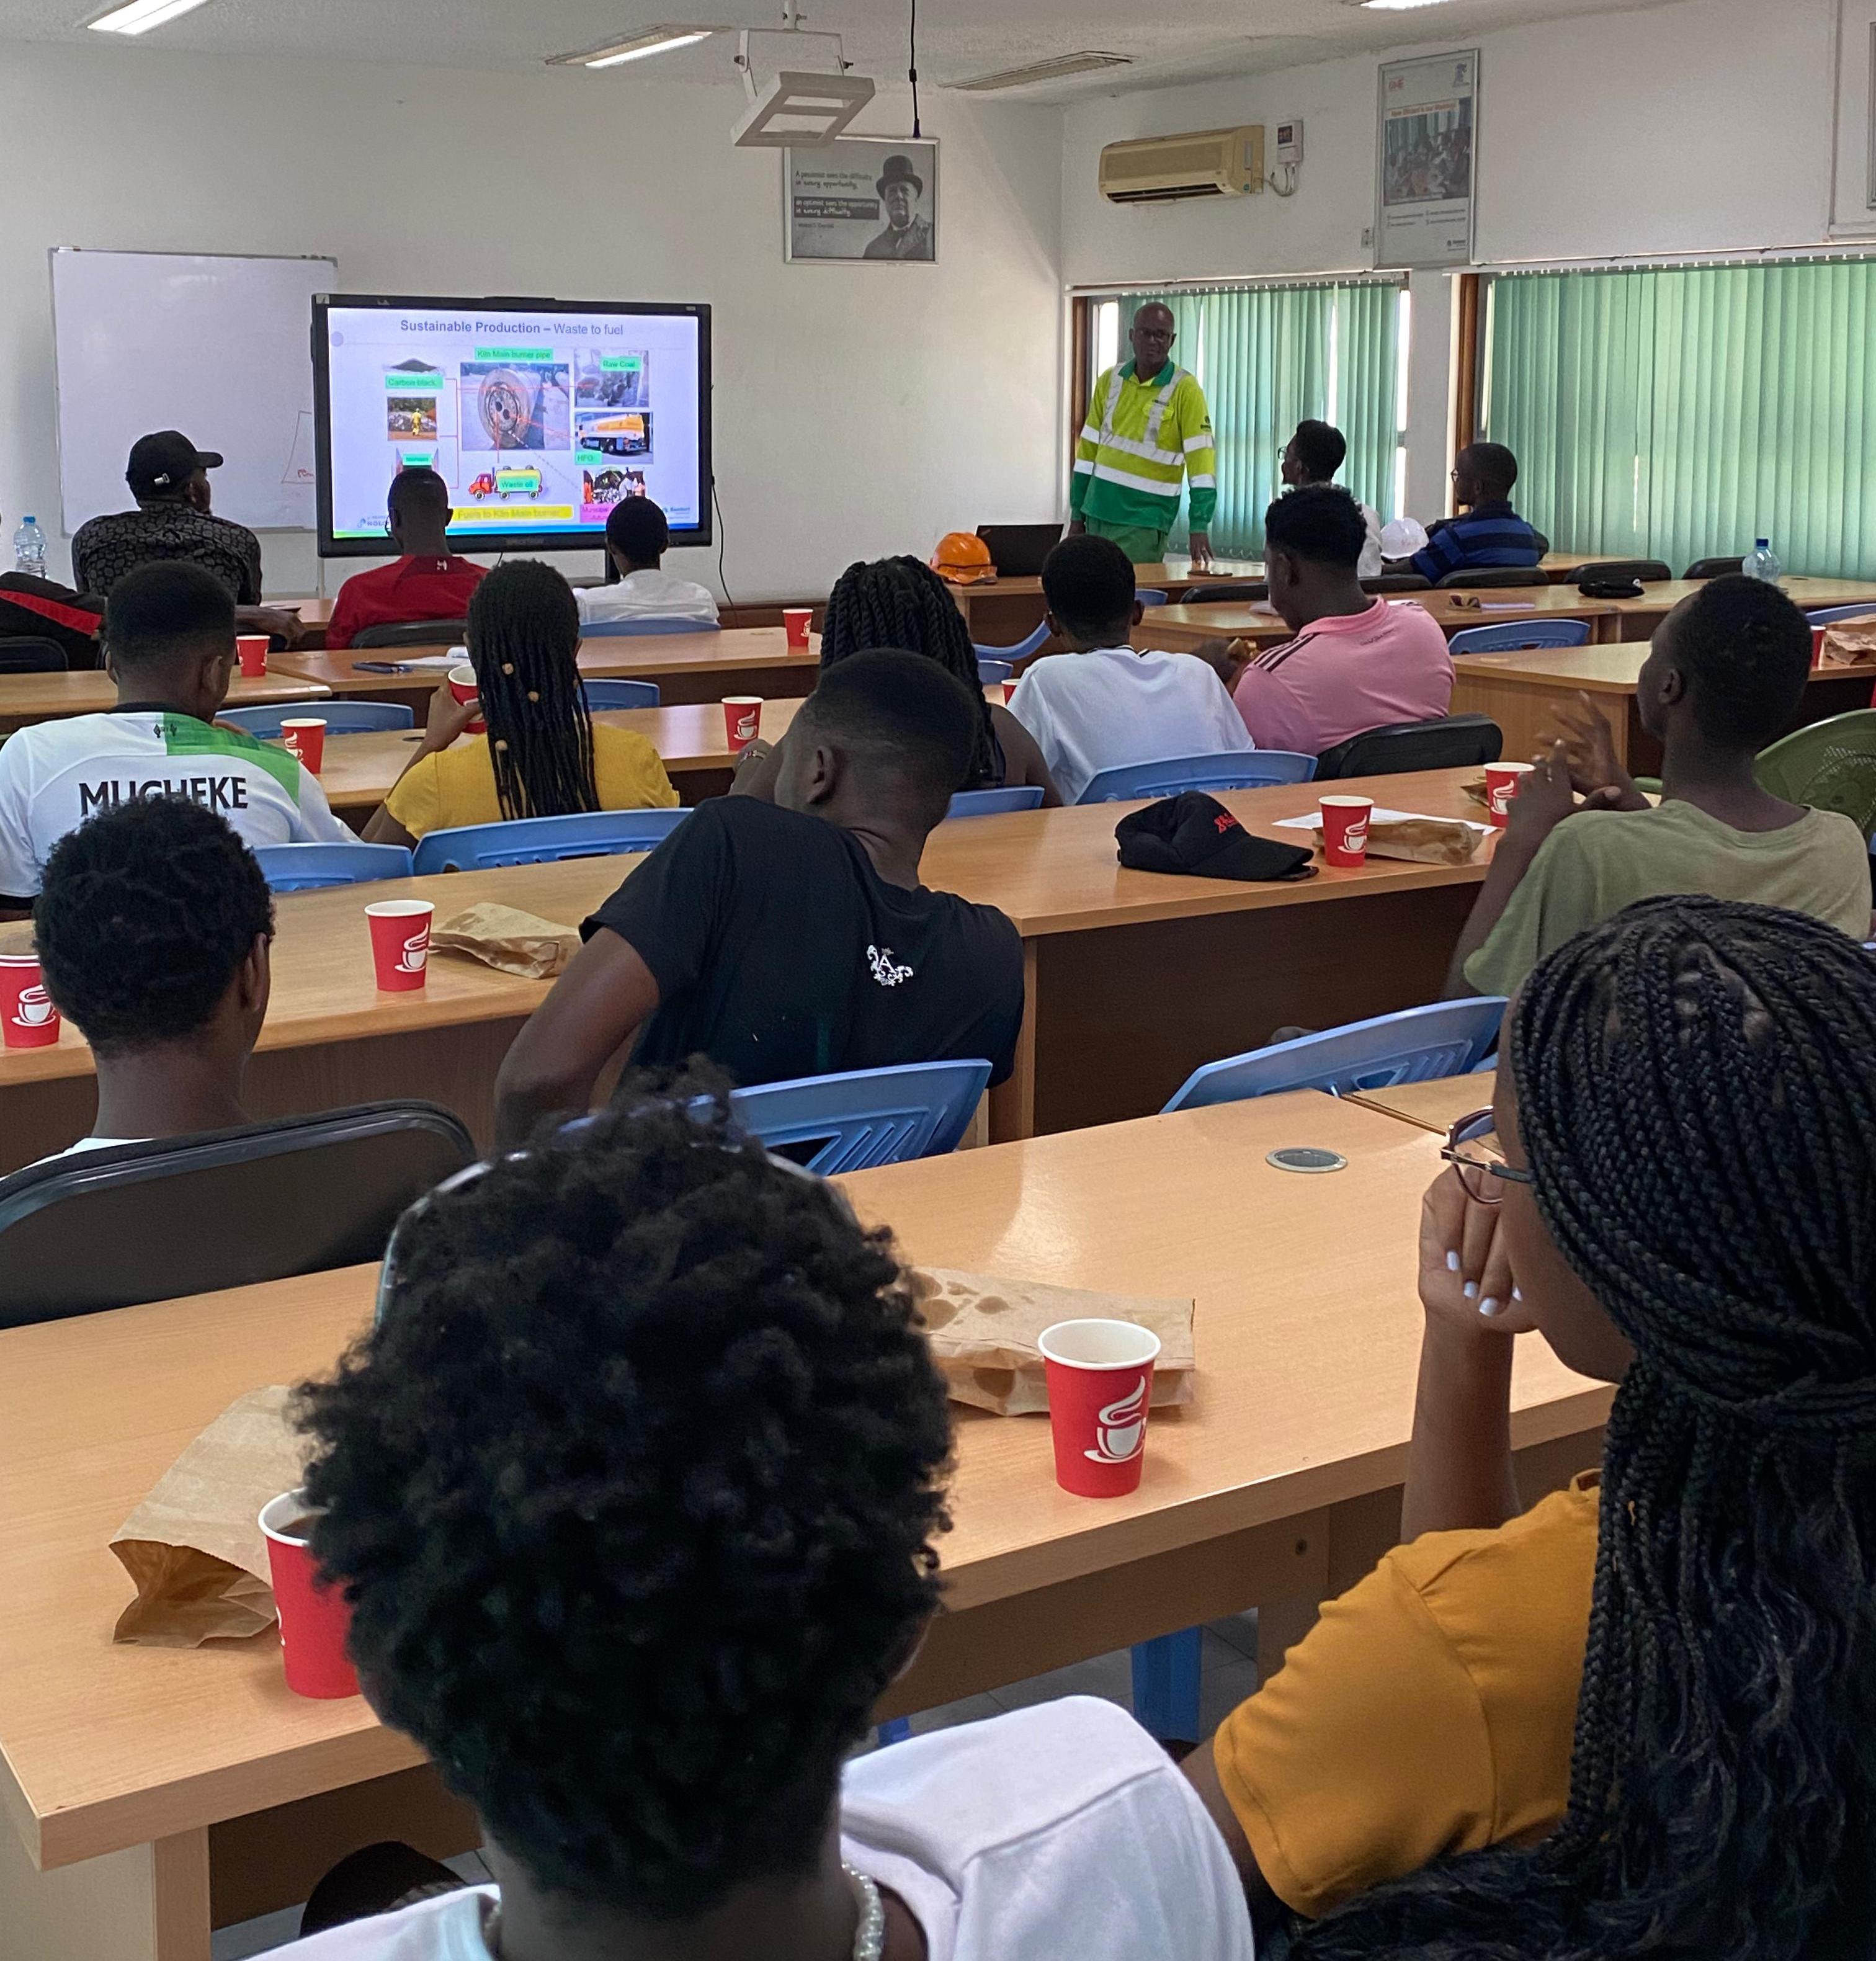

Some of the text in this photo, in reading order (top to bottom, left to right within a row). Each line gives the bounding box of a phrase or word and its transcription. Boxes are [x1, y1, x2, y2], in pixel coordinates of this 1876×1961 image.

[400, 319, 471, 332] Sustainable
[475, 321, 540, 333] Production
[553, 323, 588, 334] Waste
[591, 324, 601, 335] to
[604, 324, 623, 336] fuel
[535, 352, 550, 360] pipe
